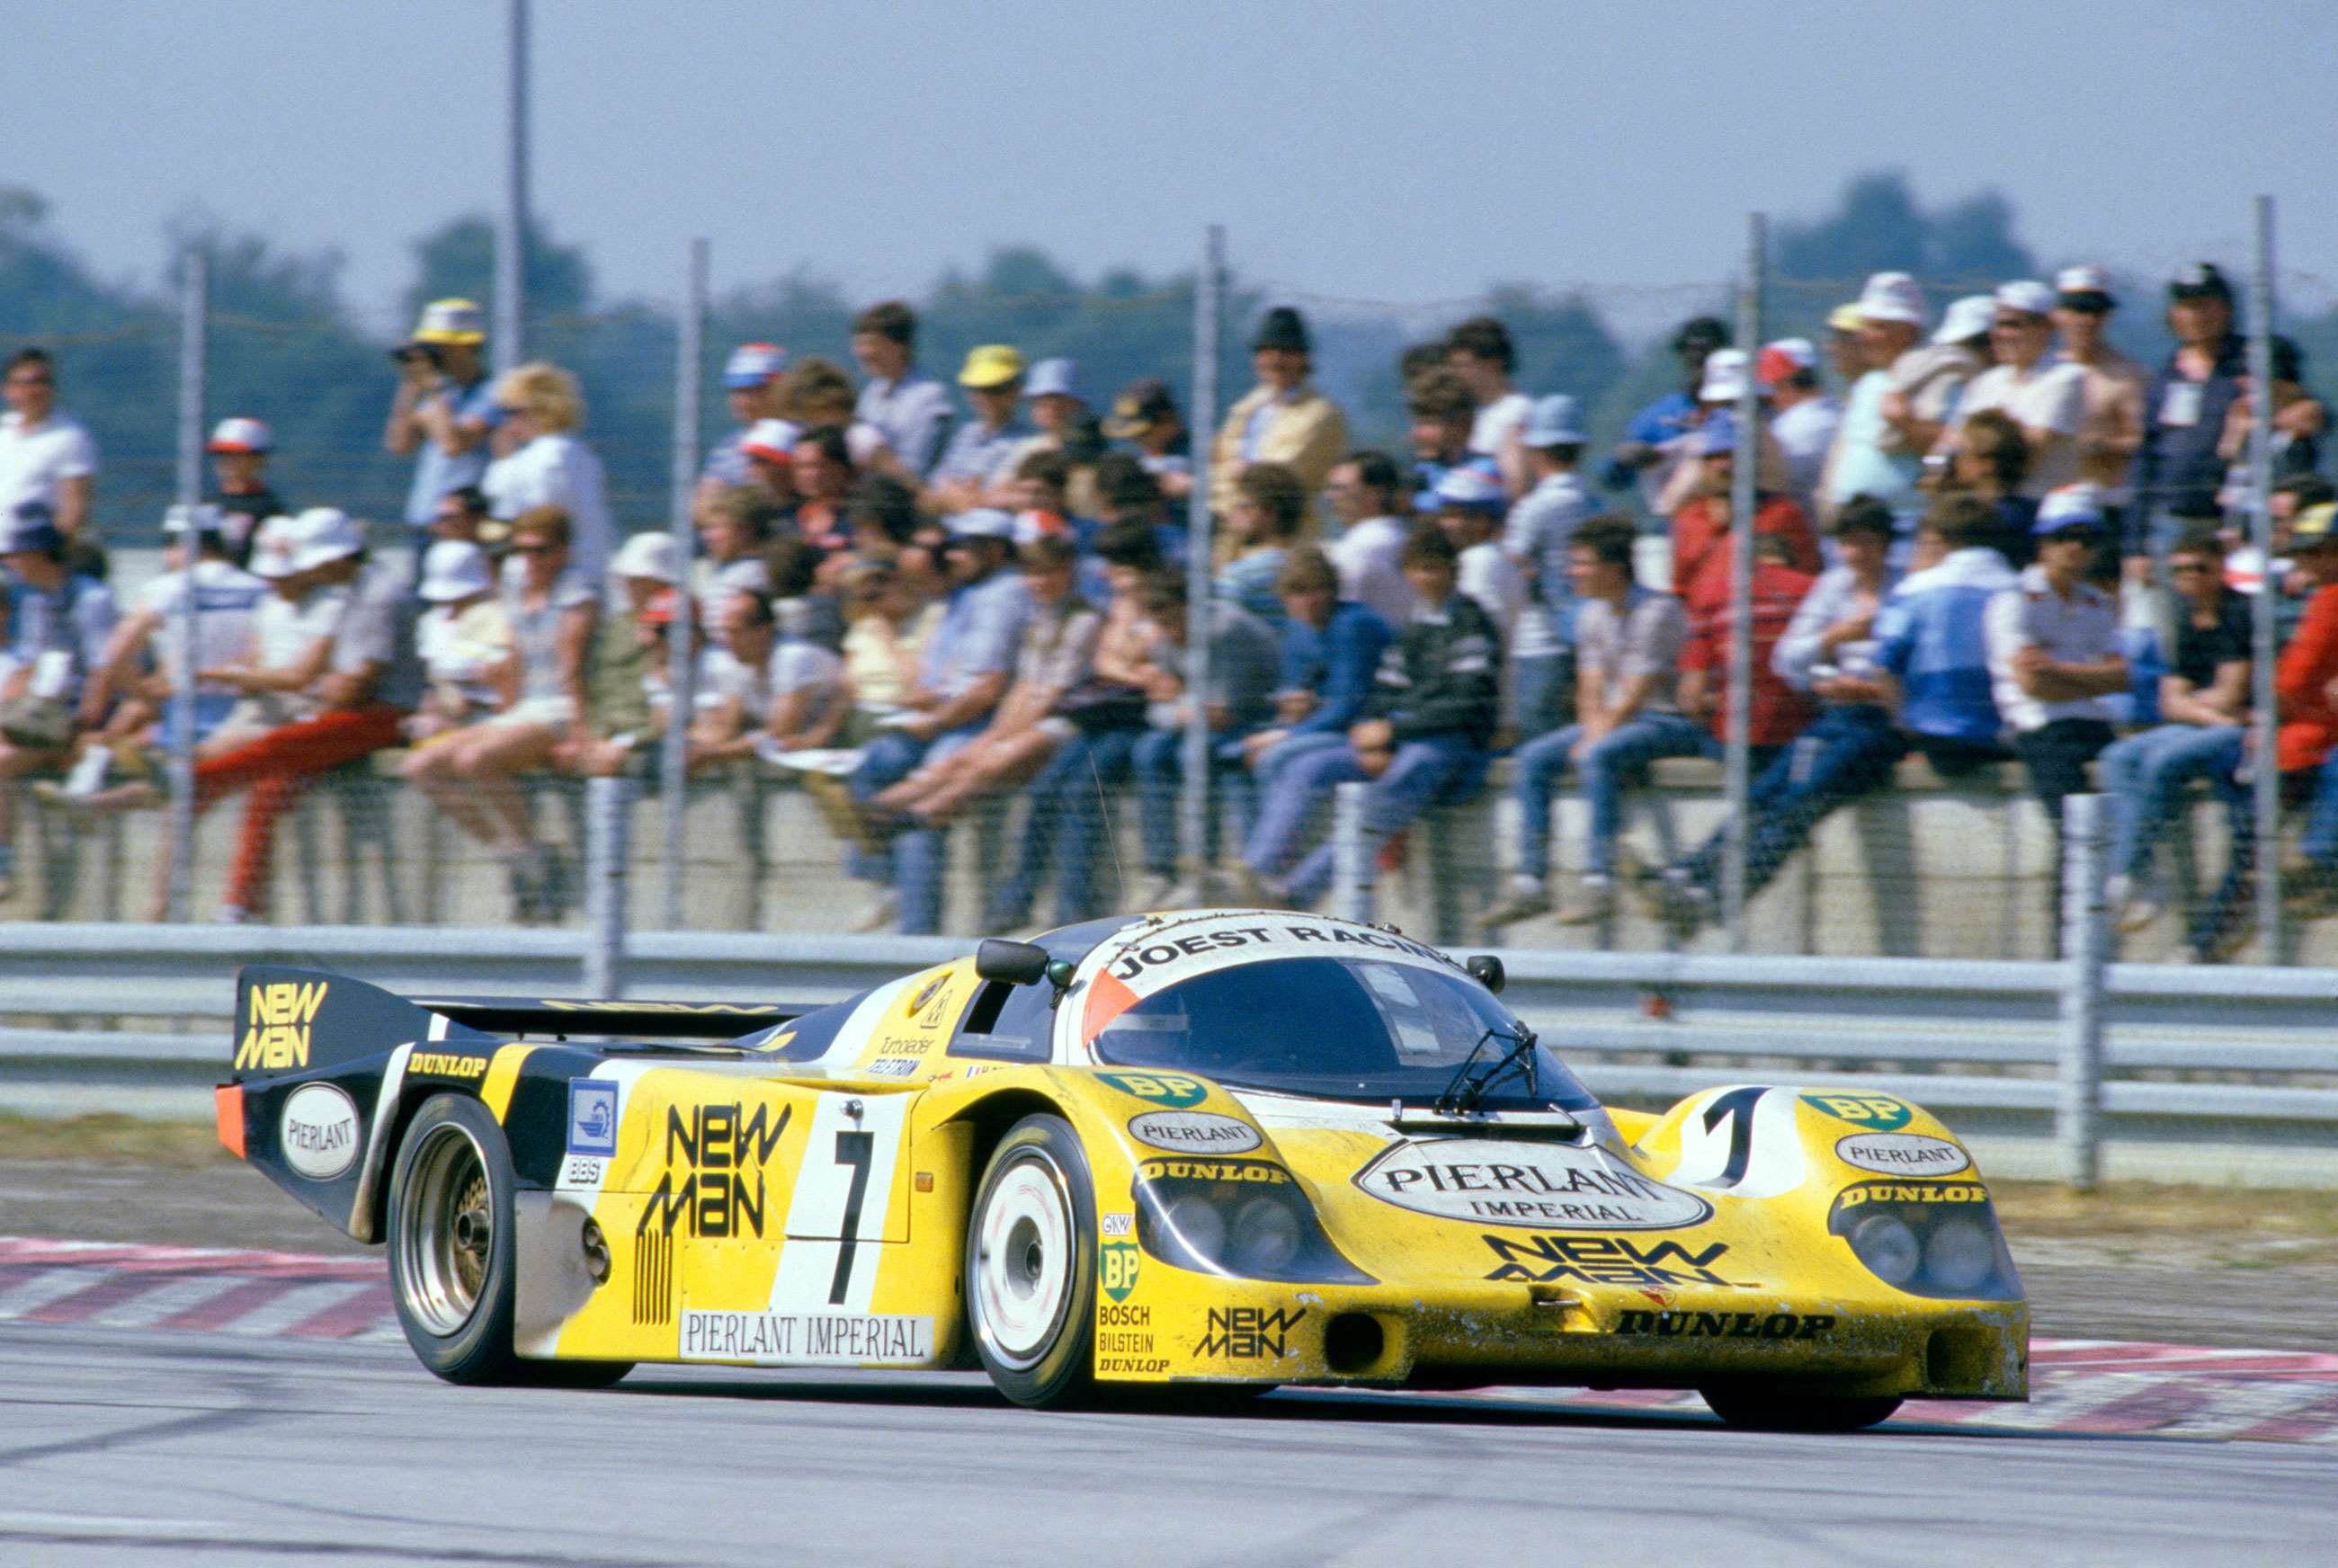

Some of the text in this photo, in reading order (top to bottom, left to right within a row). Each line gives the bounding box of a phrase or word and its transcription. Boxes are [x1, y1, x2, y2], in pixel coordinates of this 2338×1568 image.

[1117, 927, 1450, 981] JOEST RACIN
[408, 1053, 487, 1077] DUNLOP
[1112, 1074, 1199, 1097] BP
[1817, 1095, 1902, 1120] BP
[288, 1118, 352, 1152] PIERLANT
[1143, 1123, 1250, 1142] PIERLANT
[1851, 1146, 1956, 1164] PIERLANT
[568, 1158, 600, 1184] BBS
[1138, 1162, 1295, 1185] DUNLOP
[1384, 1163, 1663, 1201] PIERLANT
[1841, 1186, 1988, 1210] DUNLOP
[828, 1131, 874, 1305] 7
[1469, 1201, 1645, 1223] IMPERIAL
[1103, 1246, 1138, 1288] BP
[1100, 1305, 1150, 1326] BOSCH
[1618, 1308, 1836, 1340] DUNLOP
[687, 1314, 924, 1359] PIERLANT IMPERIAL
[1100, 1333, 1154, 1354] BILSTEIN
[1099, 1359, 1170, 1373] DUNLOP
